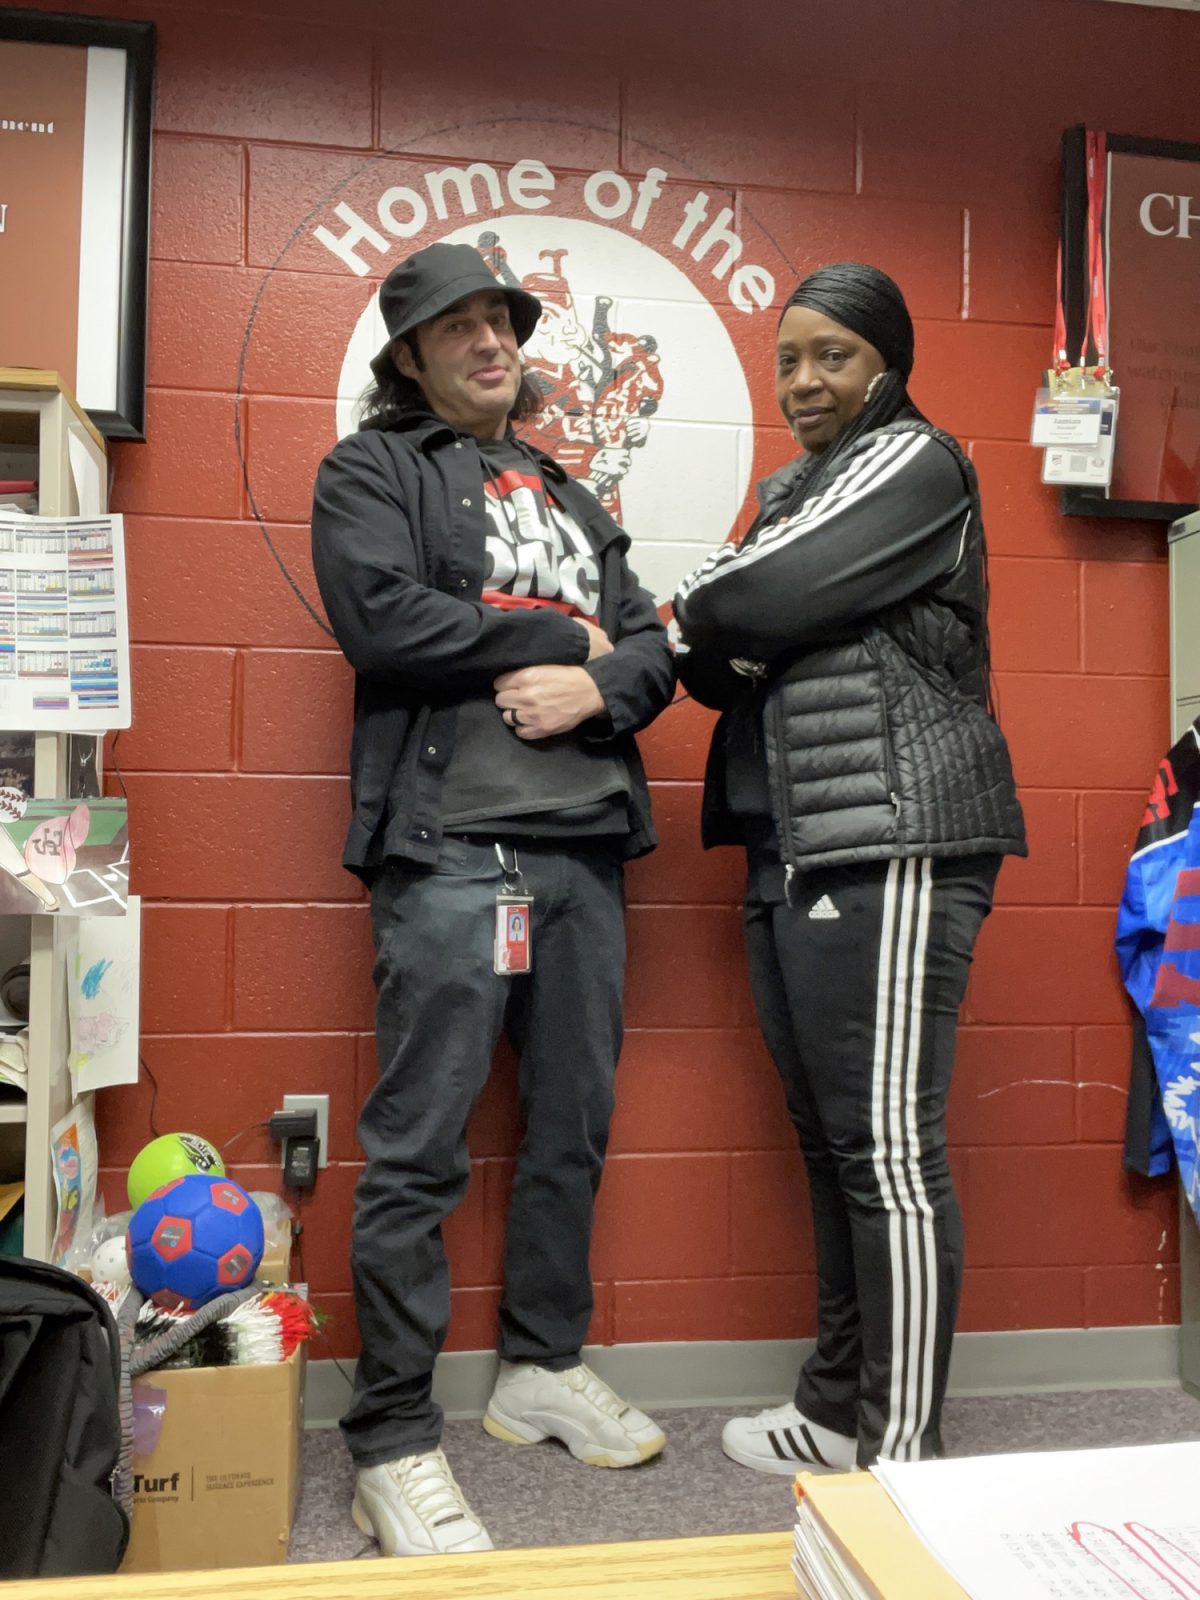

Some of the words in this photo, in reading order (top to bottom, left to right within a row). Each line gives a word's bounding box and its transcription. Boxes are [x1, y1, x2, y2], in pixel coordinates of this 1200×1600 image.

[313, 159, 556, 277] Home
[583, 167, 669, 231] of
[672, 190, 776, 314] the
